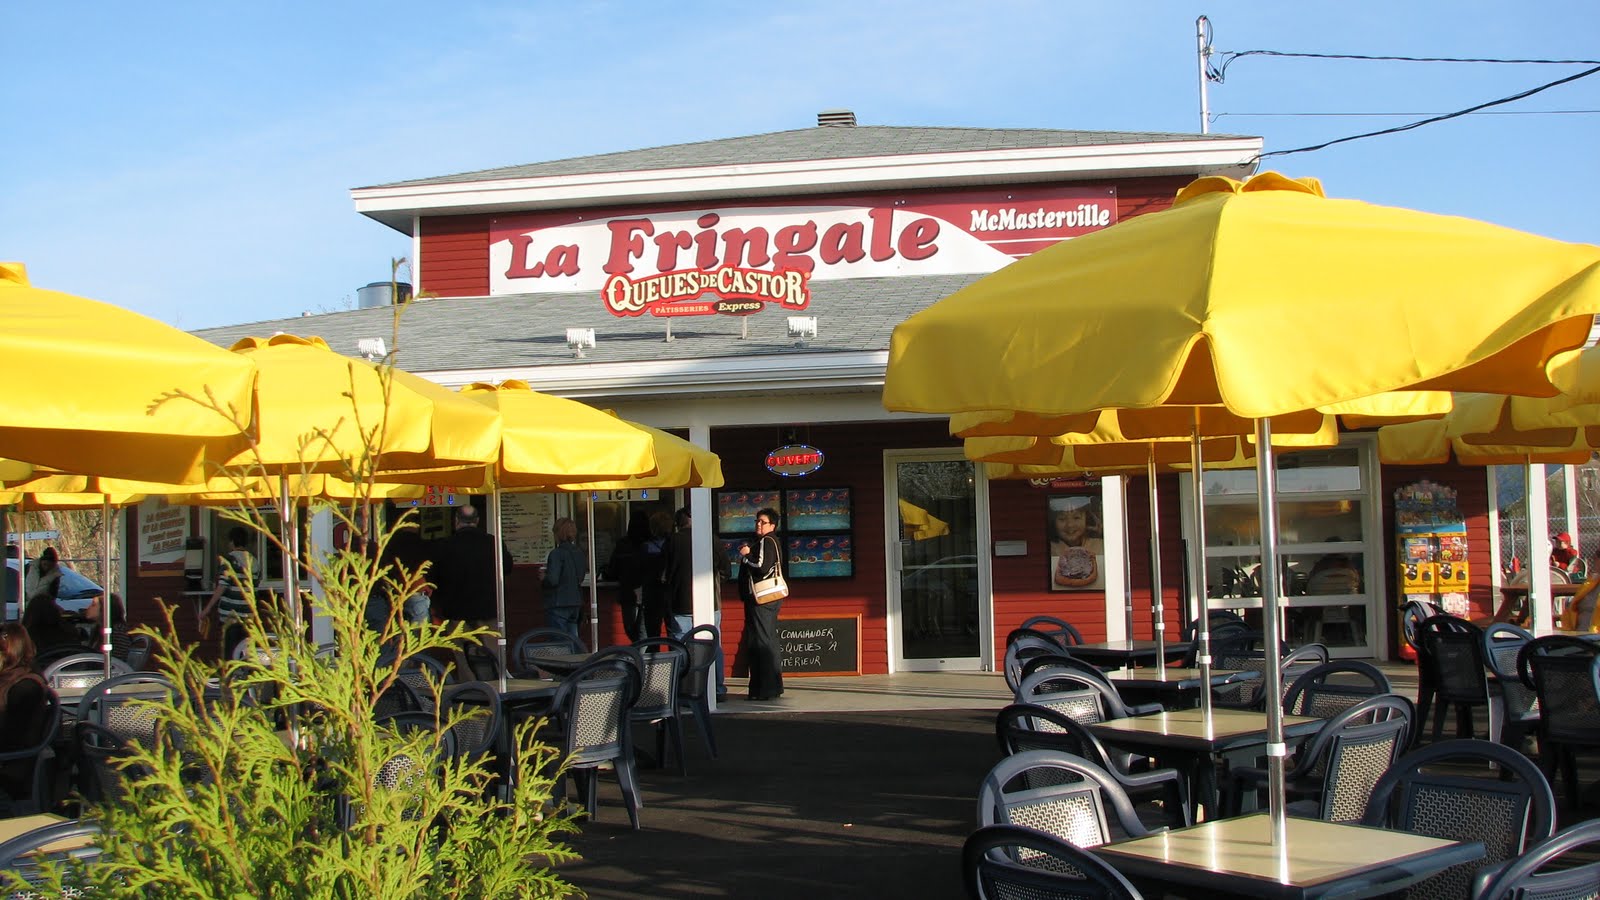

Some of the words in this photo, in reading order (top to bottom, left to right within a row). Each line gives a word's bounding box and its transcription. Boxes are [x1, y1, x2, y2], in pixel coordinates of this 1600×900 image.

[969, 204, 1110, 232] McMasterville
[505, 234, 581, 279] La
[603, 207, 941, 274] Fringale
[606, 270, 700, 311] QUEUES
[700, 273, 717, 289] DE
[717, 267, 806, 305] CASTOR
[718, 302, 761, 312] Express
[767, 453, 819, 467] OUVERT
[422, 494, 443, 506] ICI
[608, 490, 631, 500] ICI
[780, 627, 834, 639] COMMANDER
[785, 642, 821, 654] QUEUES
[780, 655, 821, 667] TÉRIEUR
